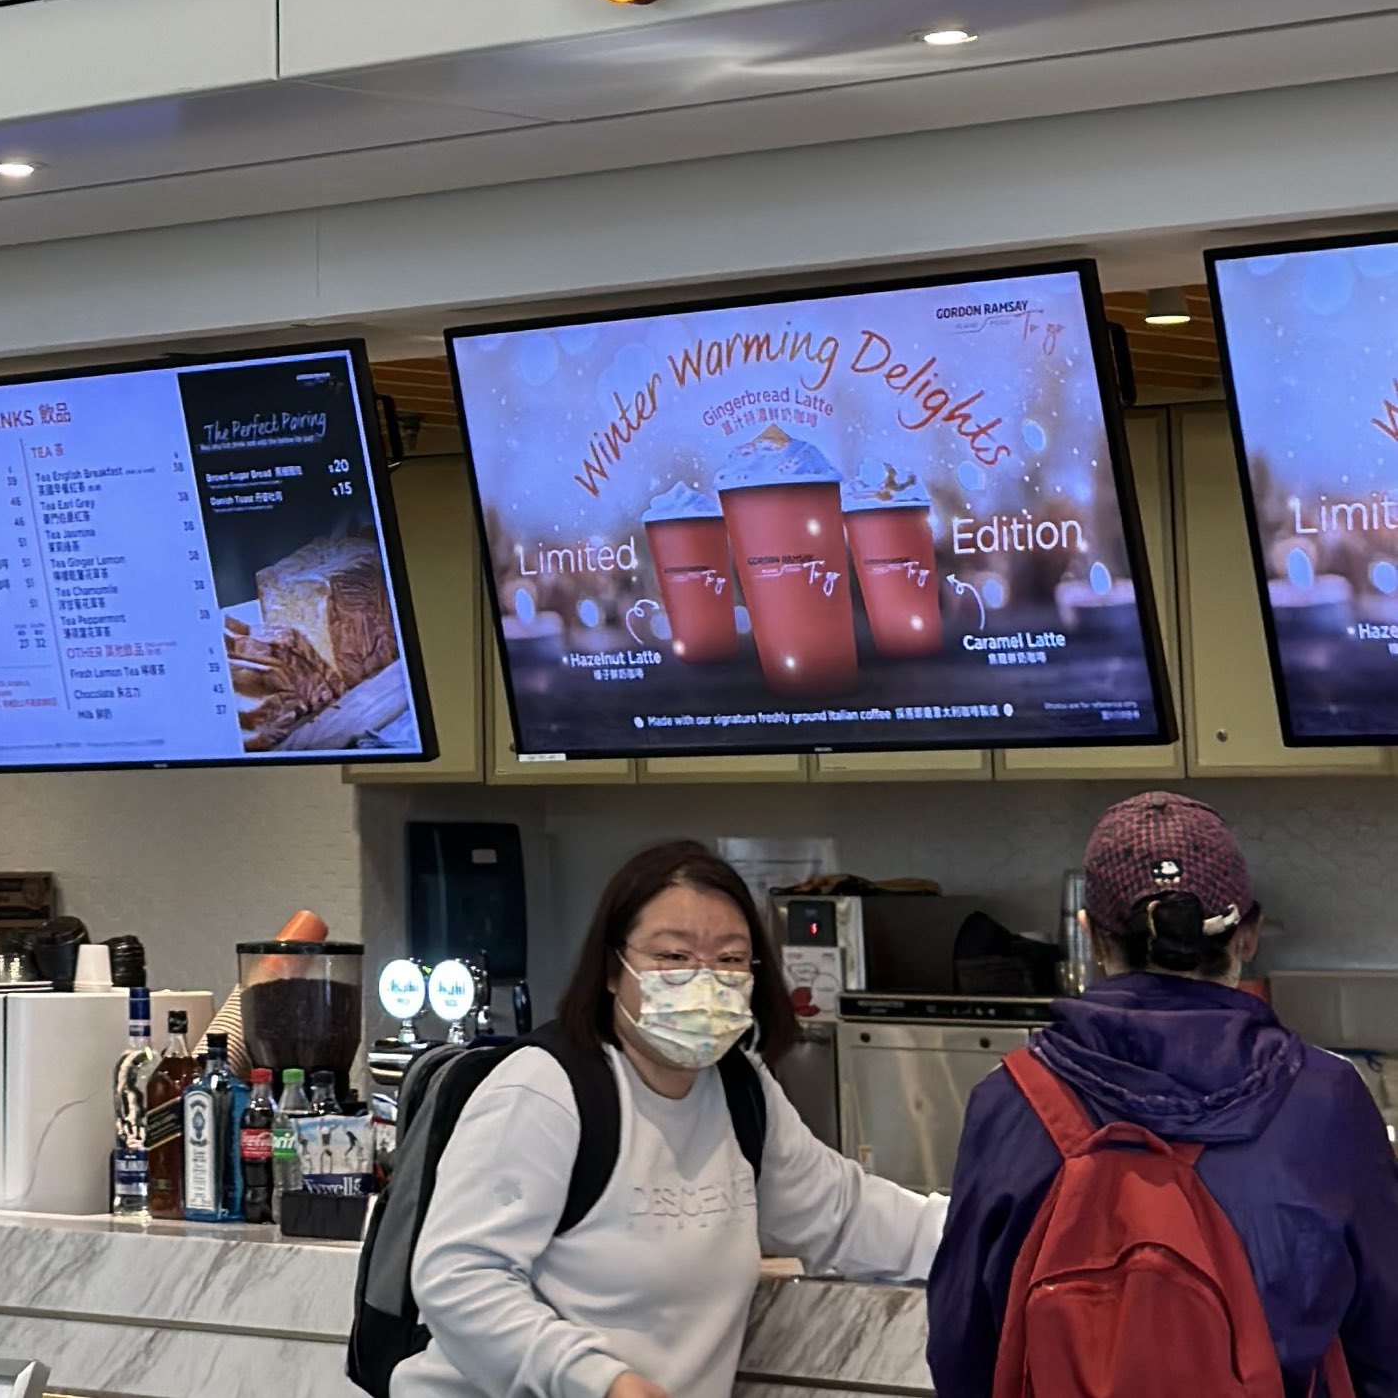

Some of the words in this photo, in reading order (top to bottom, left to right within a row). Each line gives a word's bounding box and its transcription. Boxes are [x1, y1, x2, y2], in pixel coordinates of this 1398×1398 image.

[936, 304, 982, 319] GORDON
[983, 301, 1028, 315] RAMSAY
[38, 402, 72, 424] 飲品
[574, 372, 662, 498] Winter
[667, 321, 840, 392] Warming
[850, 330, 1011, 466] Delights
[702, 387, 790, 426] Gingerbread
[795, 388, 833, 416] Latte
[203, 421, 230, 443] The
[232, 413, 280, 439] Perfect
[281, 410, 327, 438] Pairing
[31, 446, 52, 458] TEA
[36, 472, 51, 483] Tea
[53, 469, 82, 483] English
[84, 466, 123, 479] Breakfast
[205, 472, 229, 483] Brown
[229, 470, 250, 482] Sugar
[250, 469, 272, 479] Bread
[328, 458, 350, 473] $20
[331, 481, 352, 497] $15
[40, 501, 56, 511] Tea
[57, 499, 73, 510] Earl
[74, 498, 95, 510] Grey
[45, 529, 62, 540] Tea
[63, 528, 97, 539] Jasmine
[518, 535, 636, 576] Limited
[952, 516, 1082, 555] Edition
[50, 558, 66, 569] Tea
[67, 557, 95, 570] Ginger
[96, 555, 126, 566] Lemon
[55, 587, 72, 597] Tea
[73, 584, 118, 596] Chamomile
[60, 615, 77, 626] Tea
[78, 614, 126, 626] Peppermint
[963, 632, 1024, 651] Caramel
[1027, 631, 1066, 648] Latte
[66, 647, 102, 660] OTHER
[569, 651, 626, 667] Hazelnut
[627, 650, 662, 665] Latte
[70, 668, 93, 680] Fresh
[94, 667, 123, 678] Lemon
[123, 666, 140, 677] Tea
[73, 688, 115, 700] Chocolate
[77, 711, 95, 720] Milk
[647, 716, 673, 727] Made
[674, 714, 695, 725] with
[696, 716, 712, 725] our
[713, 713, 757, 727] signature
[757, 711, 790, 724] freshly
[791, 711, 827, 725] ground
[828, 709, 859, 720] Italian
[860, 708, 892, 720] coffee
